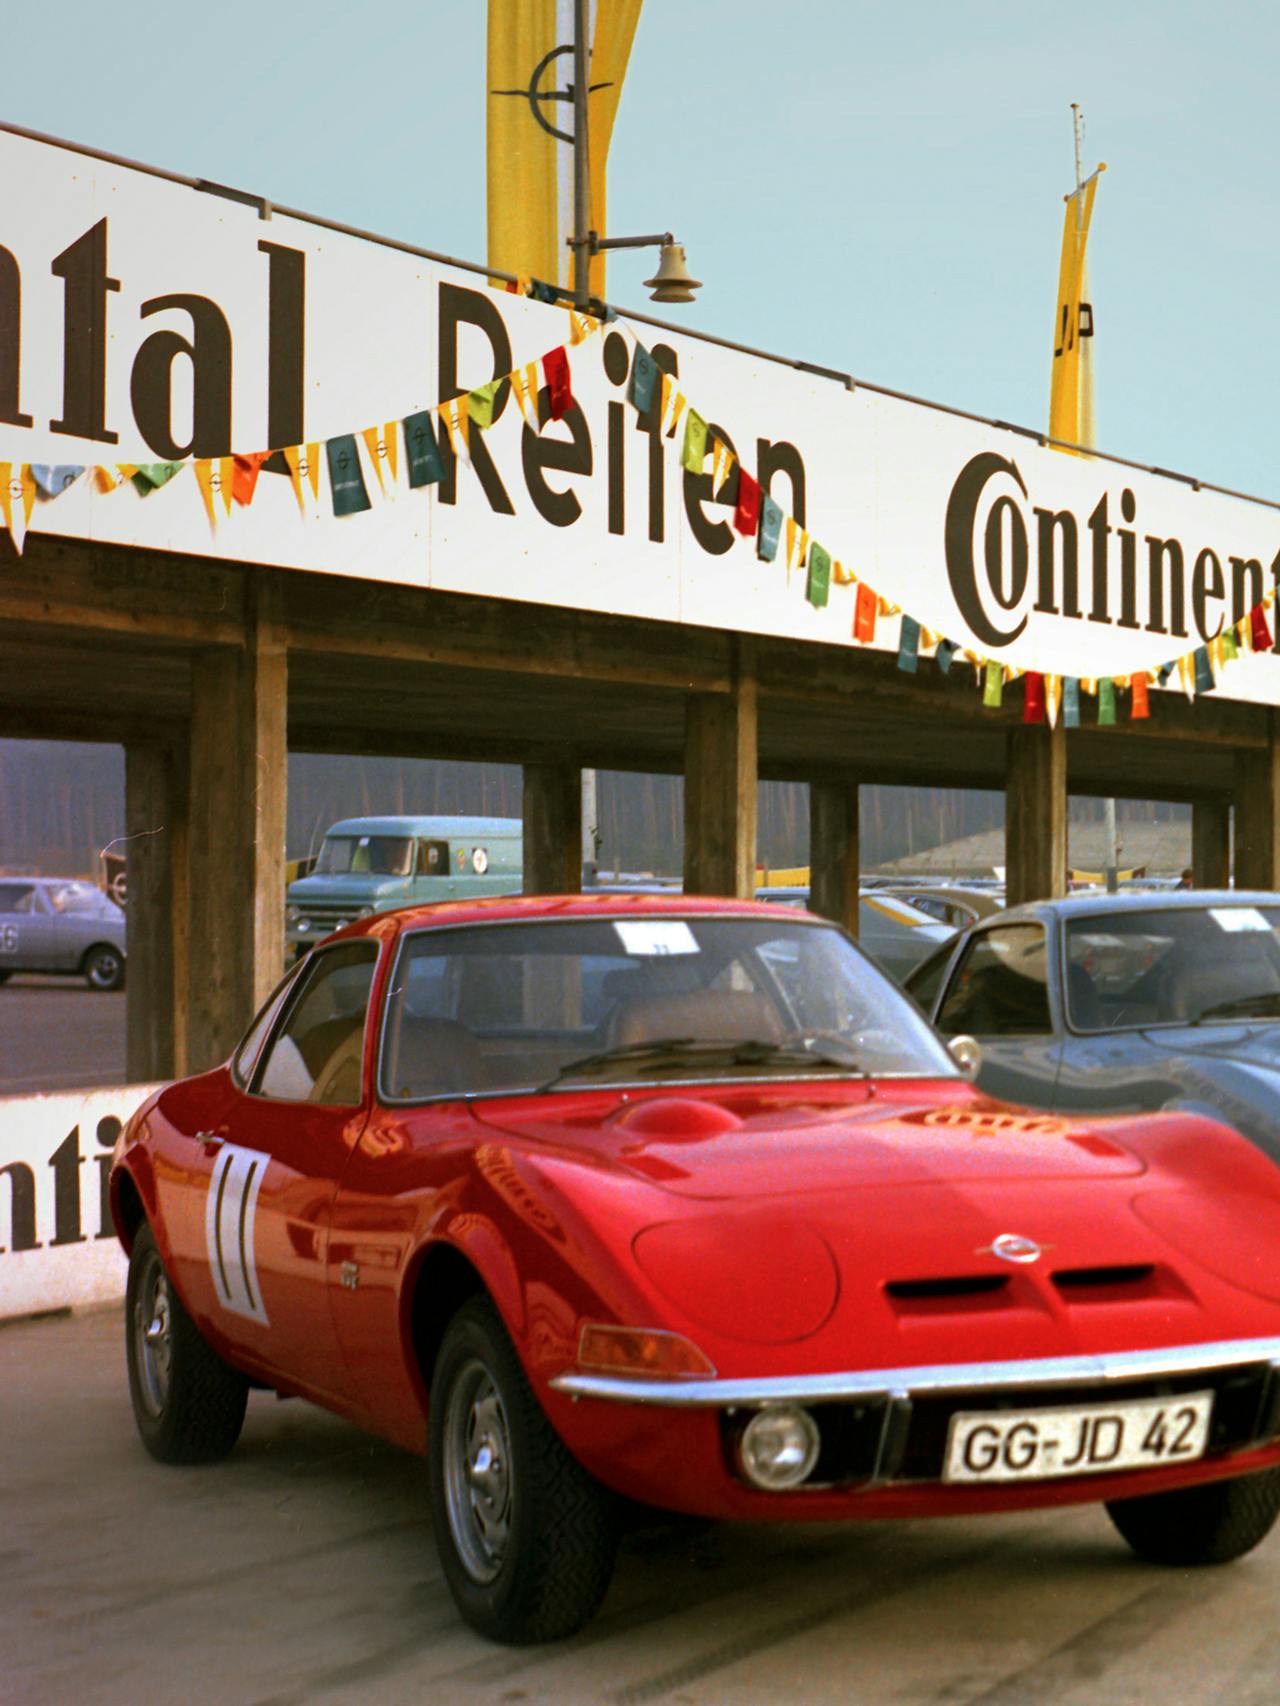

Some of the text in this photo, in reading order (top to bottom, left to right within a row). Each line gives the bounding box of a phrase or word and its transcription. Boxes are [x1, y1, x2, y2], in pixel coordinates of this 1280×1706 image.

[437, 281, 807, 557] Reifen
[962, 1406, 1197, 1473] GG-JD 42
